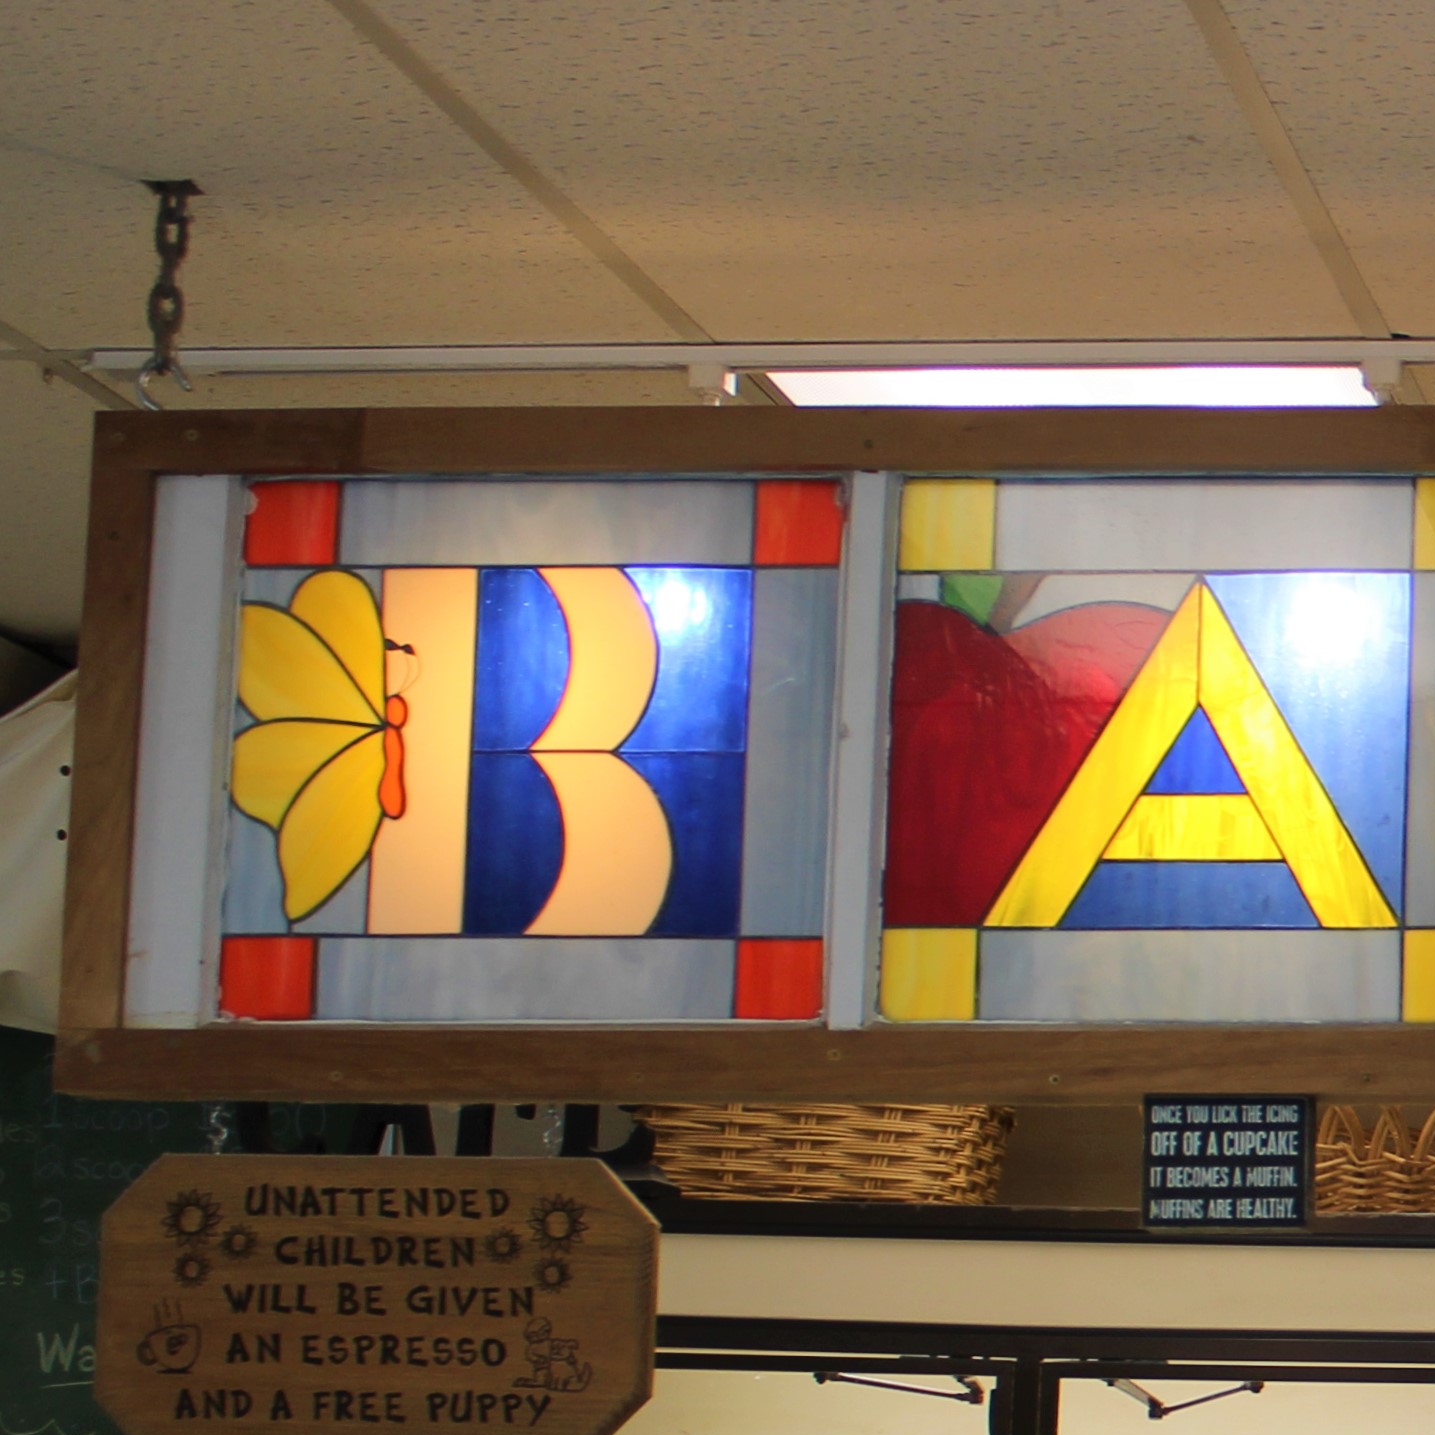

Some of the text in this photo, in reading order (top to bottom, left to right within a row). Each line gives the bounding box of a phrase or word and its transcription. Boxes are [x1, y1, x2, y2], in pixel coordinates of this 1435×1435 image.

[1152, 1105, 1298, 1123] ONCE YOU LICK THE ICING
[1151, 1131, 1298, 1156] OFF OF A CUPCAKE
[1150, 1166, 1297, 1188] IT BECOMES A MUFFIN.
[244, 1183, 510, 1219] UNATTENDED
[1150, 1198, 1296, 1219] MUFFINS ARE HEALTHY.
[274, 1234, 476, 1268] CHILDREN
[223, 1283, 535, 1318] WILL BE GIVEN
[225, 1332, 507, 1367] AN ESPRESSO
[175, 1389, 552, 1427] AND A FREE PUPPY
